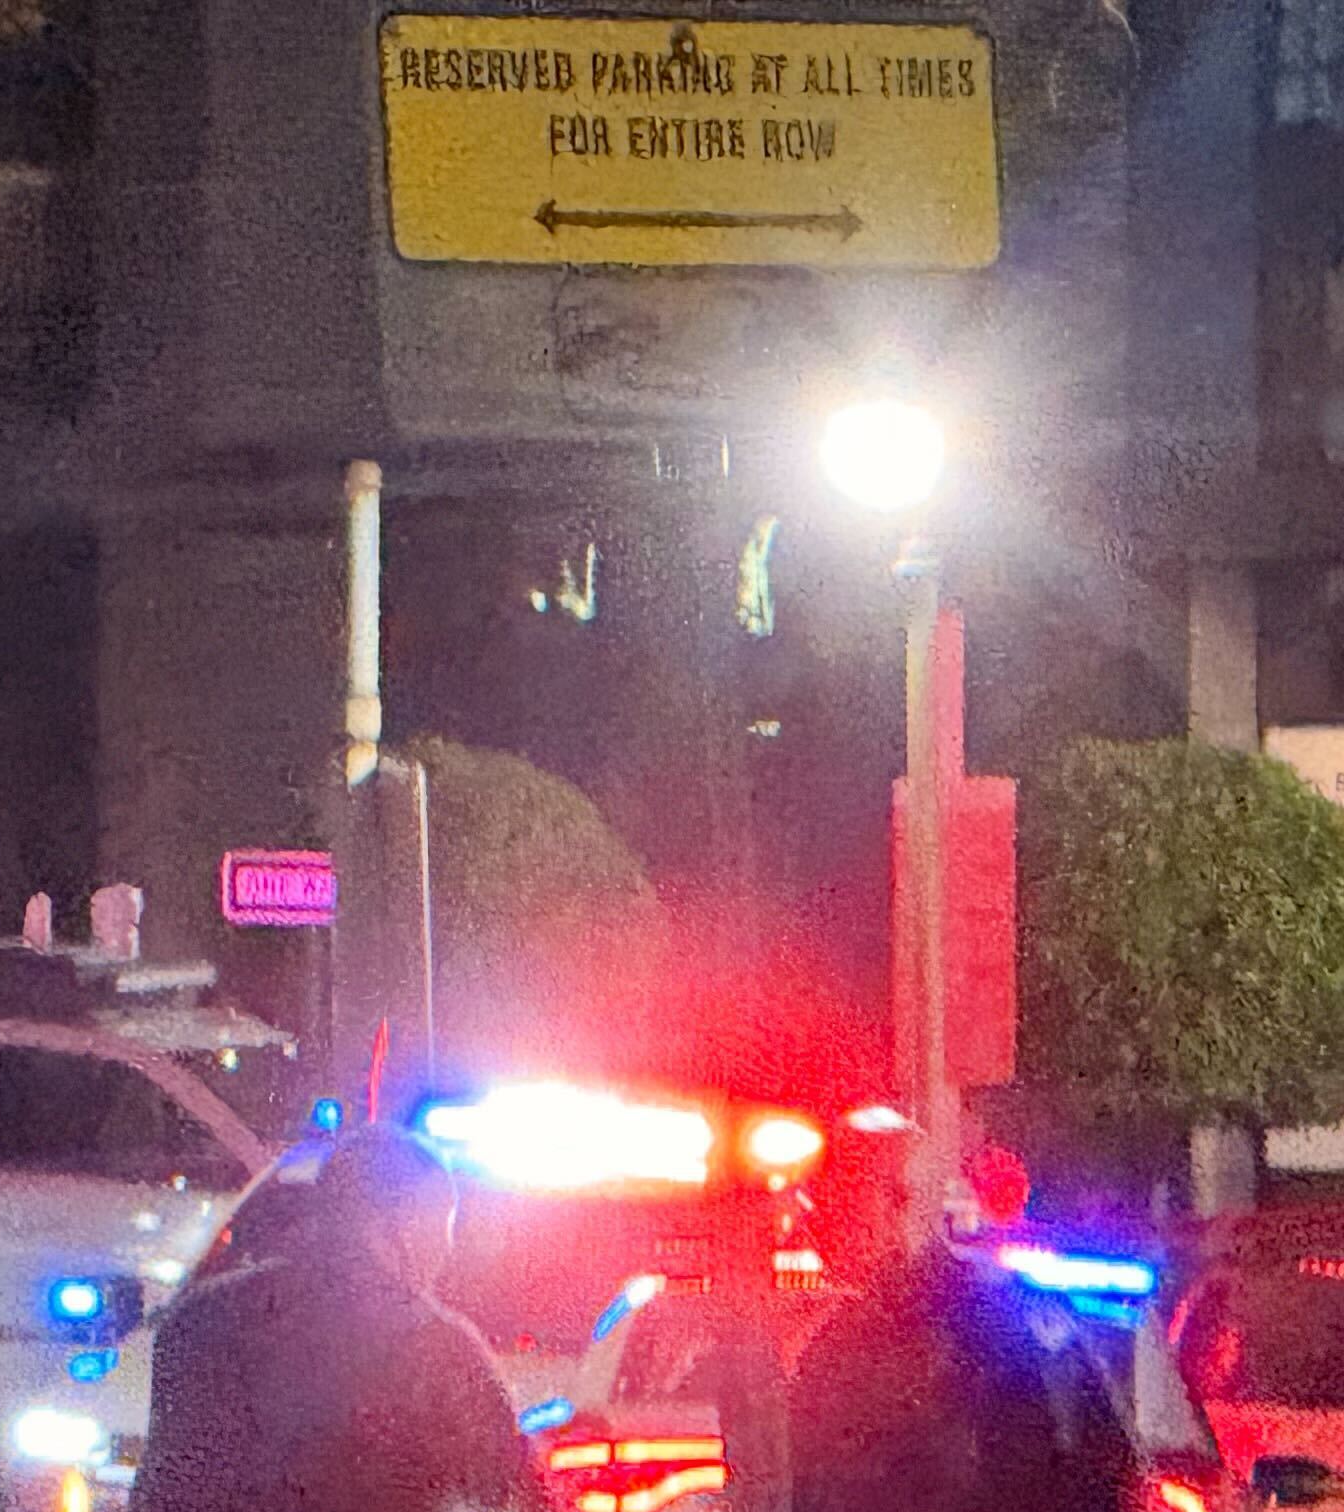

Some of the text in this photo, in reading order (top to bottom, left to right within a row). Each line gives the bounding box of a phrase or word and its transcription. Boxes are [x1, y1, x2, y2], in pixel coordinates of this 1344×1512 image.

[400, 47, 975, 98] RESERVED PARKING AT ALL TIMES
[550, 113, 836, 161] FOR ENTIRE ROW
